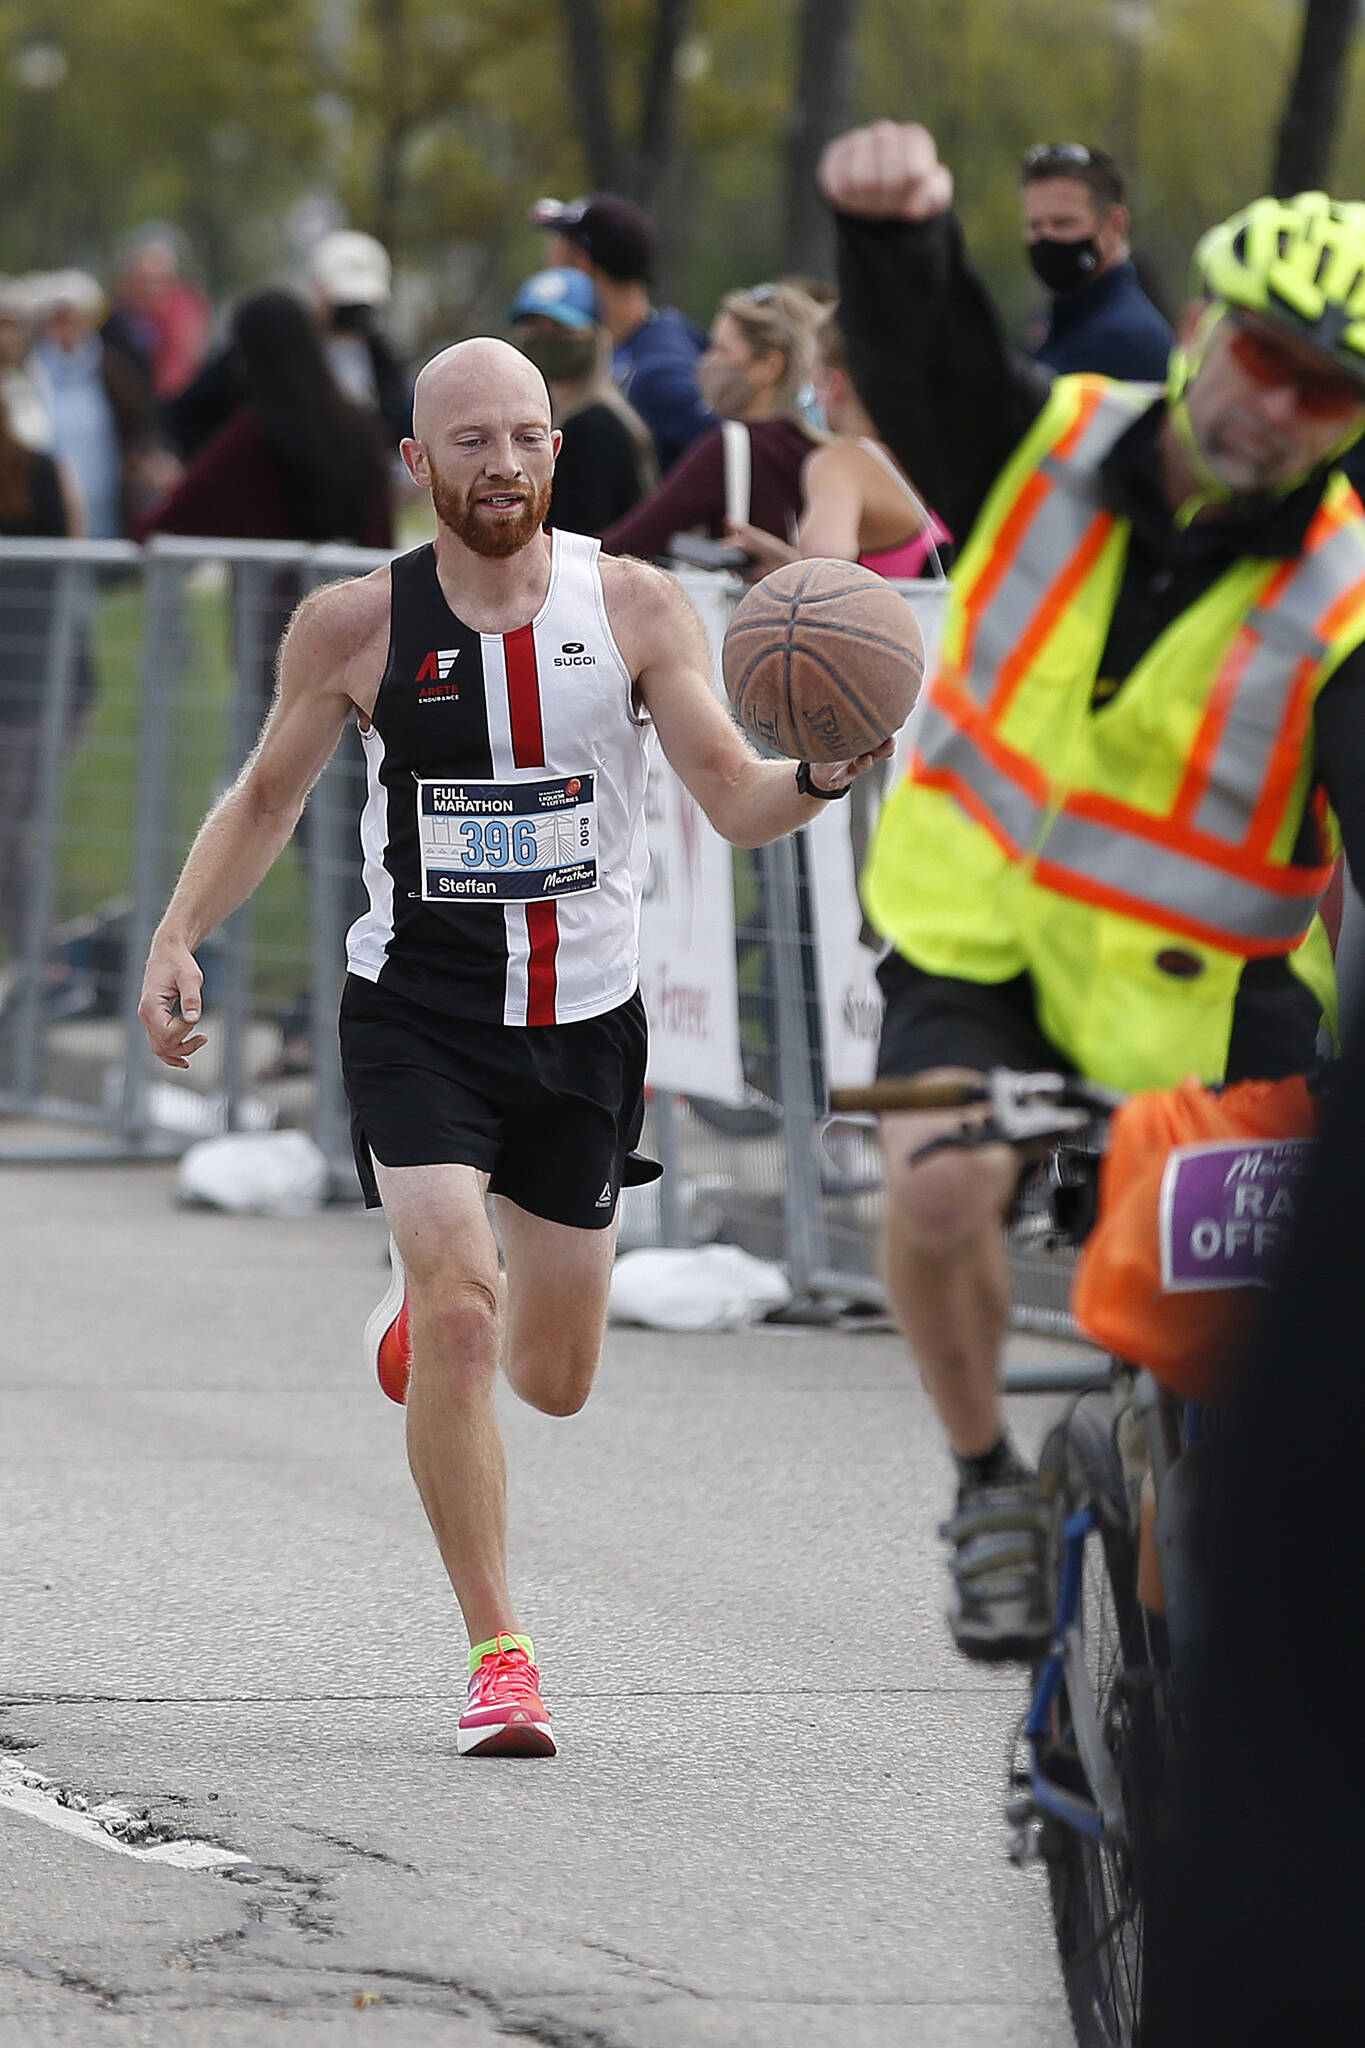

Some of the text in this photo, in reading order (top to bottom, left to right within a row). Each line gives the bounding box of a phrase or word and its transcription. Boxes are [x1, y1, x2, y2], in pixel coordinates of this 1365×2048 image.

[553, 656, 596, 666] SUGOI
[418, 685, 459, 697] ARETE
[433, 788, 468, 800] FULL
[434, 800, 513, 812] MARATHON
[579, 817, 590, 847] 8:00
[459, 820, 538, 867] 396
[438, 877, 497, 894] Steffan
[543, 870, 594, 891] Marathon
